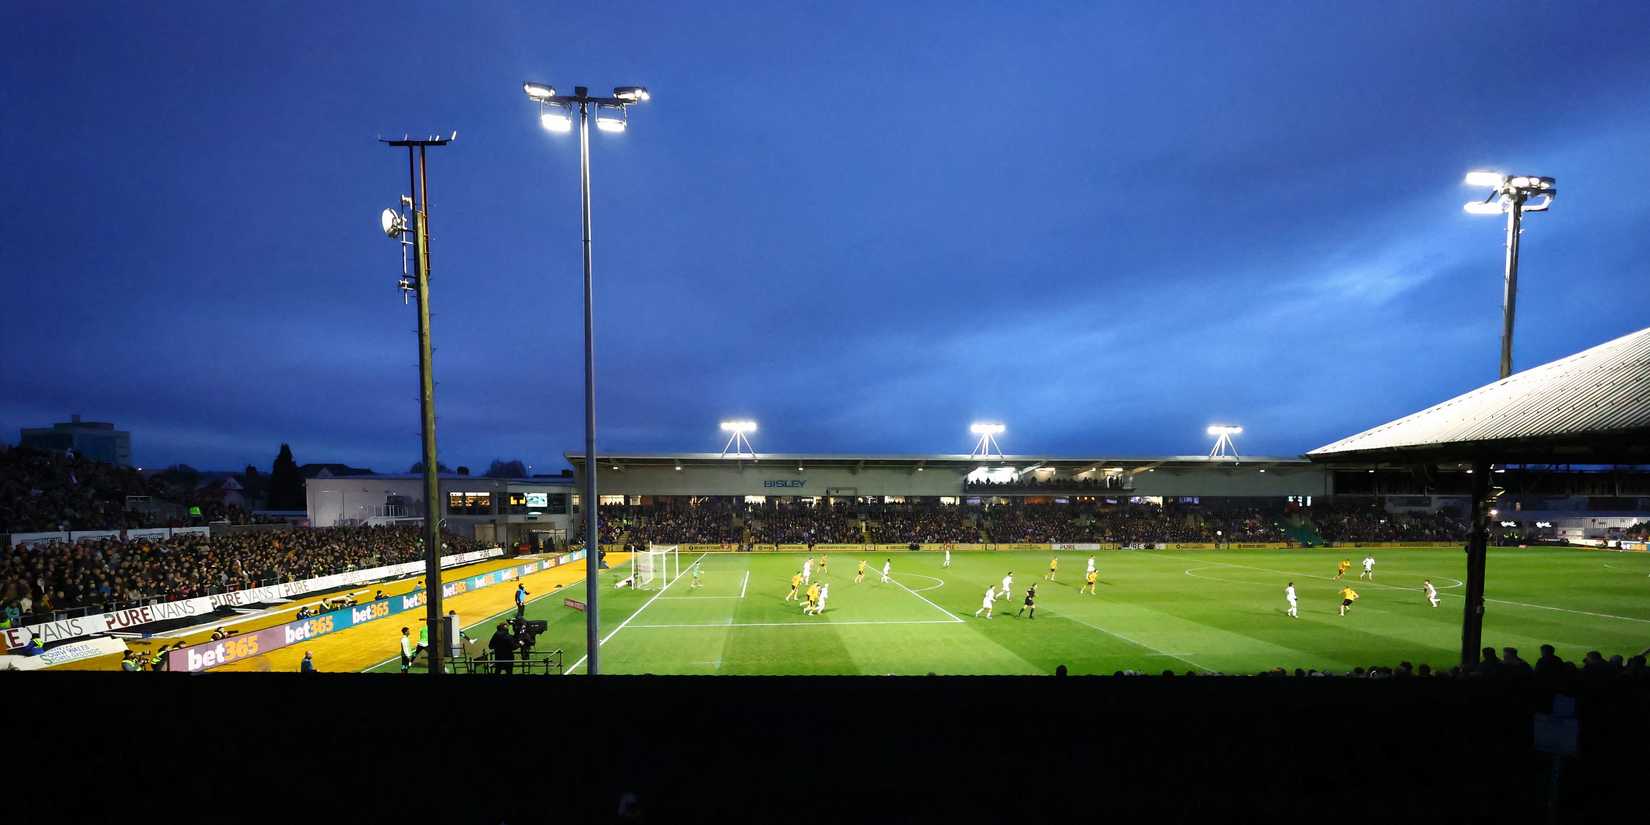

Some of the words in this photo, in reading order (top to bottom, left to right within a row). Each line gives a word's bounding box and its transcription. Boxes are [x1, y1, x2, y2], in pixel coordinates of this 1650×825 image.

[763, 479, 807, 488] BISLEY
[209, 591, 242, 612] PURE
[243, 586, 274, 603] VANS
[284, 580, 310, 596] PURE
[403, 591, 427, 610] bet36
[103, 606, 153, 630] PURE
[154, 600, 196, 619] VANS
[352, 601, 390, 625] bet365
[285, 615, 334, 644] bet365
[187, 635, 259, 672] bet365
